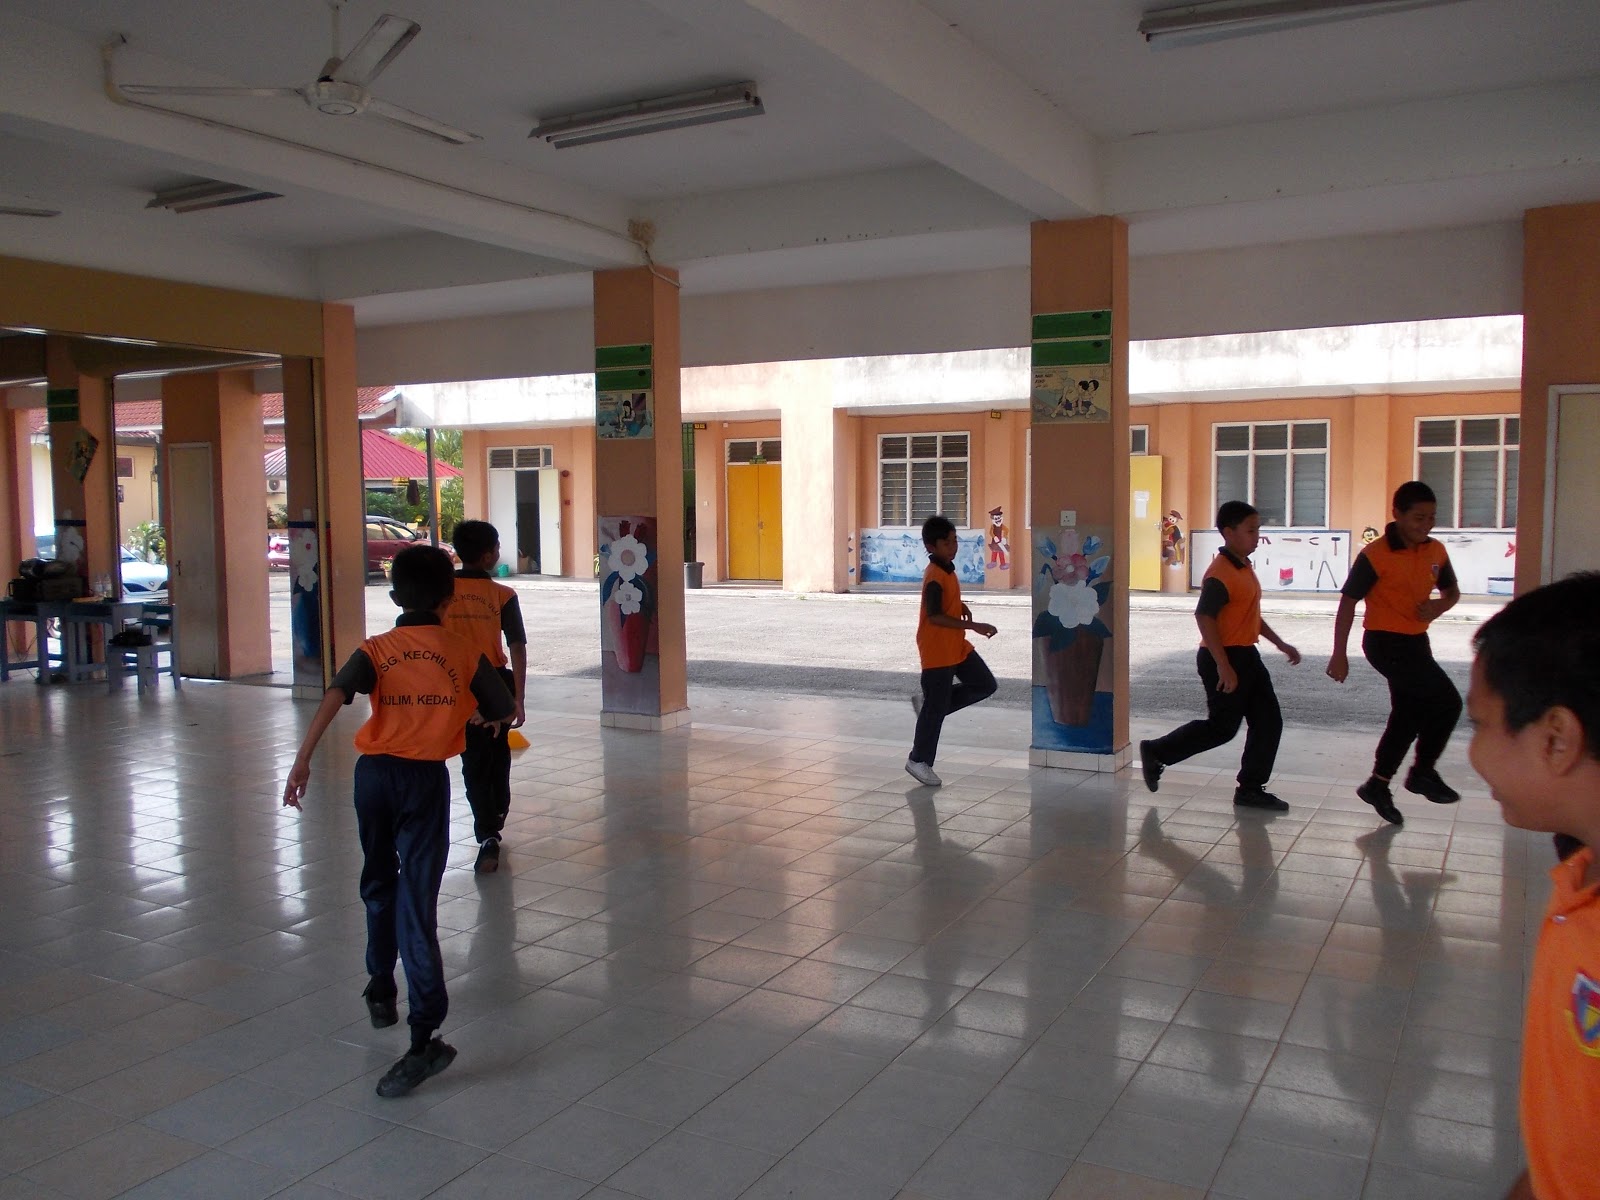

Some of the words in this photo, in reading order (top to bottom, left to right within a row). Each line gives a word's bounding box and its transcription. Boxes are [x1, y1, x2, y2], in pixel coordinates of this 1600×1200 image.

[461, 593, 486, 605] KECHIL
[403, 650, 446, 669] KECHIL
[448, 668, 460, 693] ULU
[417, 695, 456, 706] KEDAH
